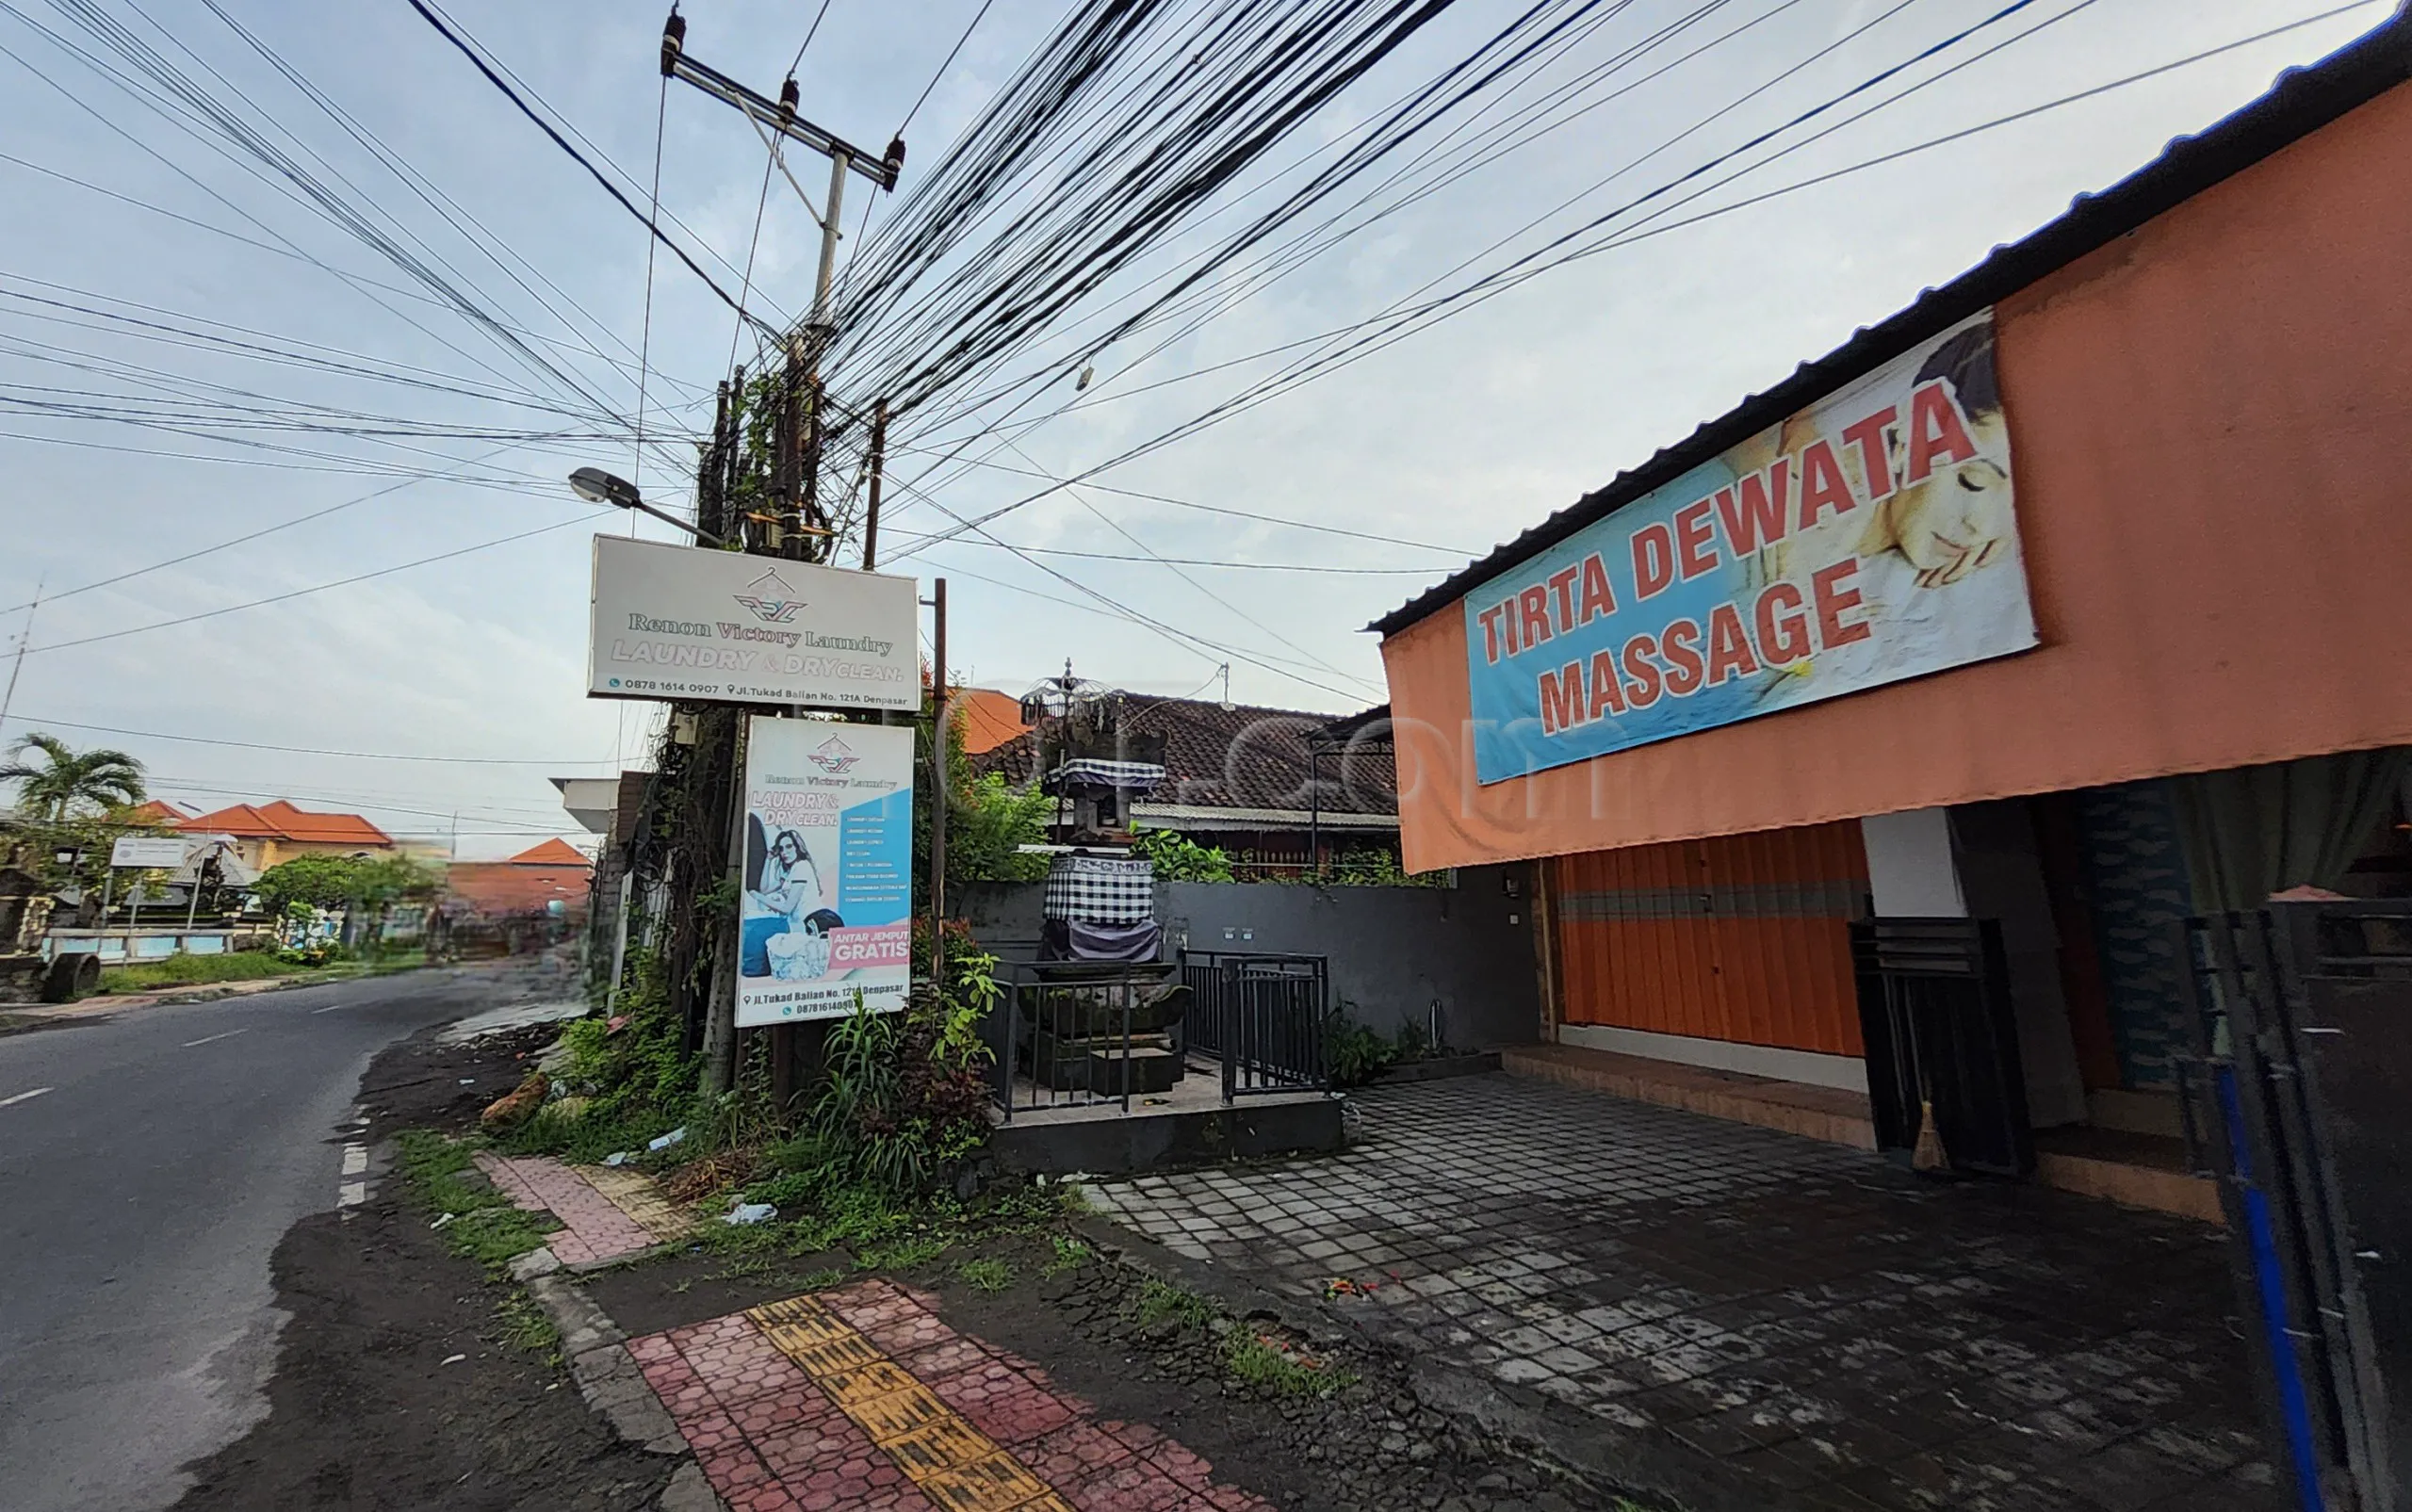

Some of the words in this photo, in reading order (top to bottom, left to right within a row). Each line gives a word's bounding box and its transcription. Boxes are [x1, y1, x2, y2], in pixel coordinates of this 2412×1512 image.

[1477, 550, 1618, 666] TIRTA
[1629, 377, 1978, 602] DEWATA
[628, 613, 711, 637] Renon
[716, 622, 801, 648] Victory
[805, 631, 892, 657] Laundry
[611, 639, 758, 671] LAUNDRY
[761, 654, 779, 673] &
[1538, 557, 1871, 738] MASSAGE
[625, 679, 656, 690] 0878
[660, 681, 686, 691] 1614
[689, 684, 719, 693] 0907
[821, 692, 837, 702] No.
[839, 693, 860, 703] 121A
[864, 695, 908, 706] Denpasar
[807, 776, 849, 789] Victory
[850, 778, 898, 790] Laundry
[834, 933, 869, 943] ANTAR
[871, 931, 909, 942] JEMPUT
[835, 941, 908, 961] GRATIS
[826, 988, 840, 999] No.
[863, 984, 904, 995] Denpasar
